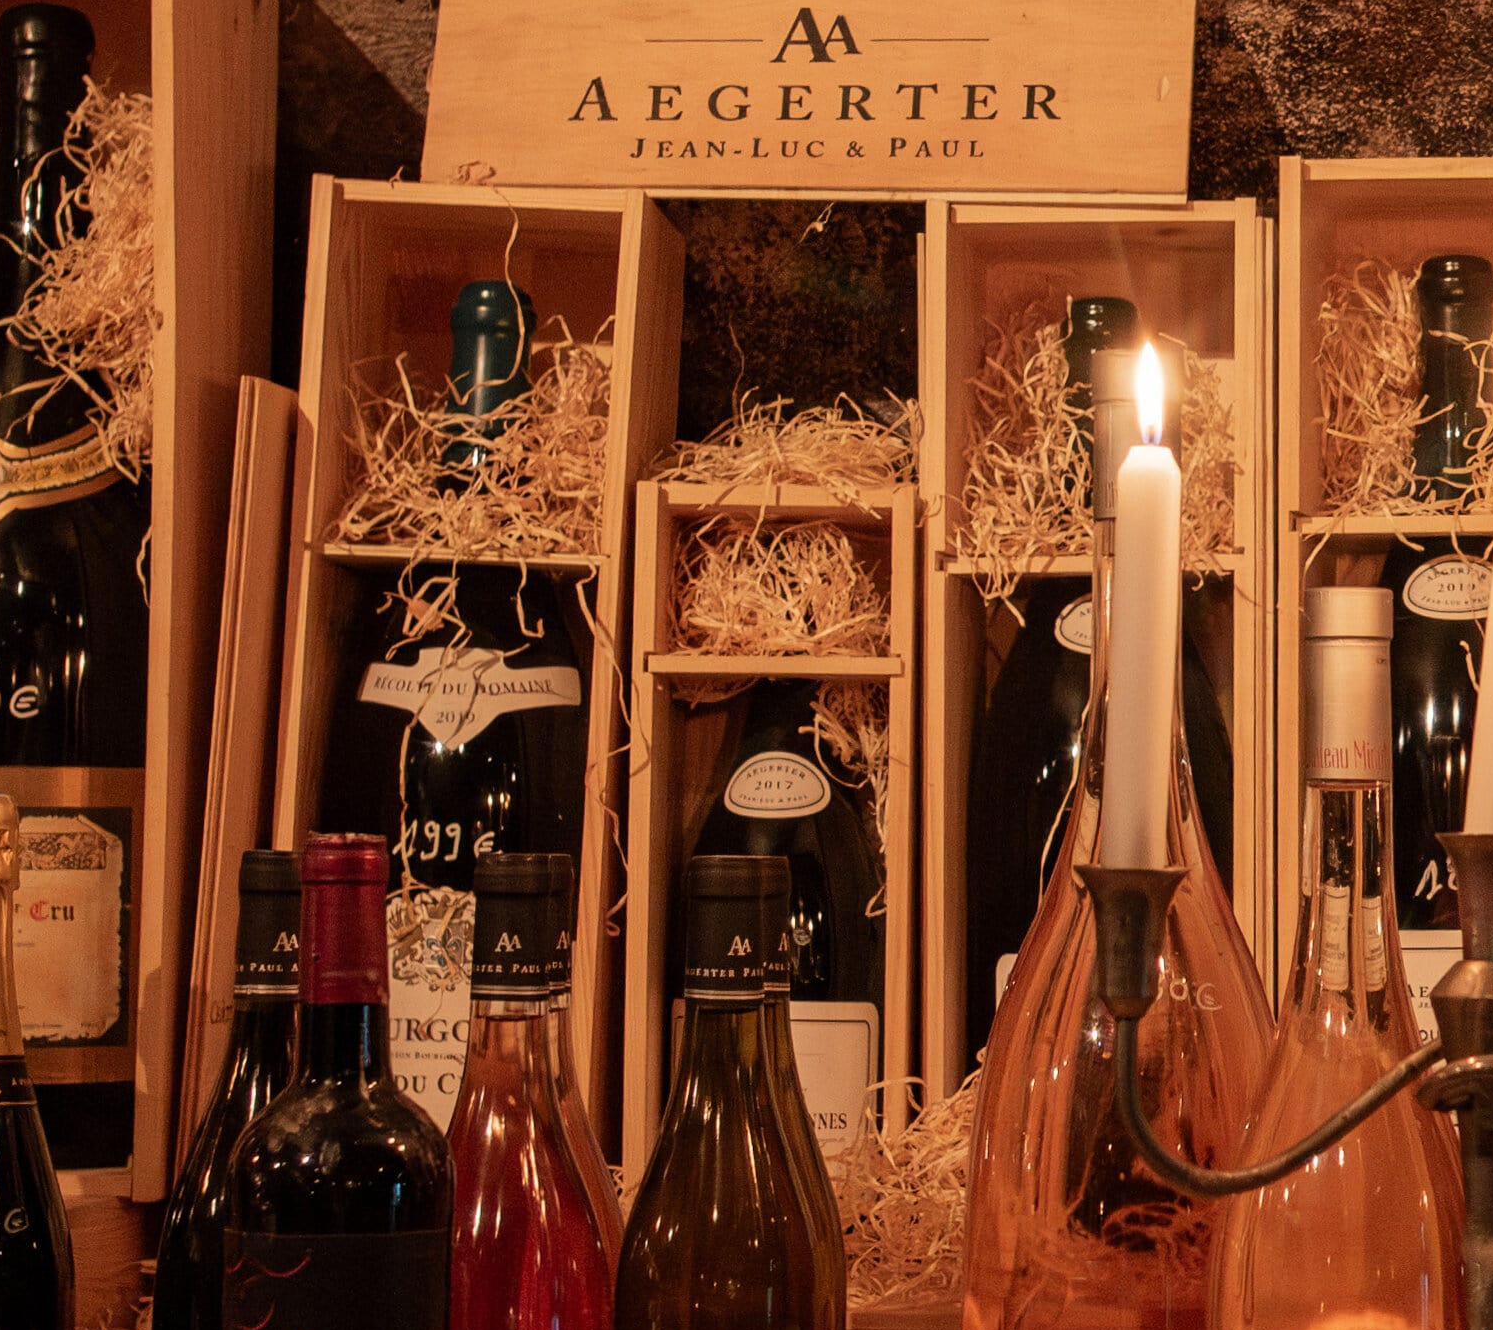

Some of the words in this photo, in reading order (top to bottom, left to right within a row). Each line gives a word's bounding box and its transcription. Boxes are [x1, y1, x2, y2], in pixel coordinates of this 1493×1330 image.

[568, 75, 1062, 123] AEGERTER
[629, 136, 827, 160] JEAN-LUC
[847, 141, 866, 159] &
[888, 137, 986, 159] PAUL
[442, 682, 468, 696] DU
[475, 678, 553, 697] DOMAINE
[754, 779, 794, 792] 2017
[392, 818, 463, 863] 199
[29, 899, 76, 922] Cru
[249, 961, 284, 973] PAUL
